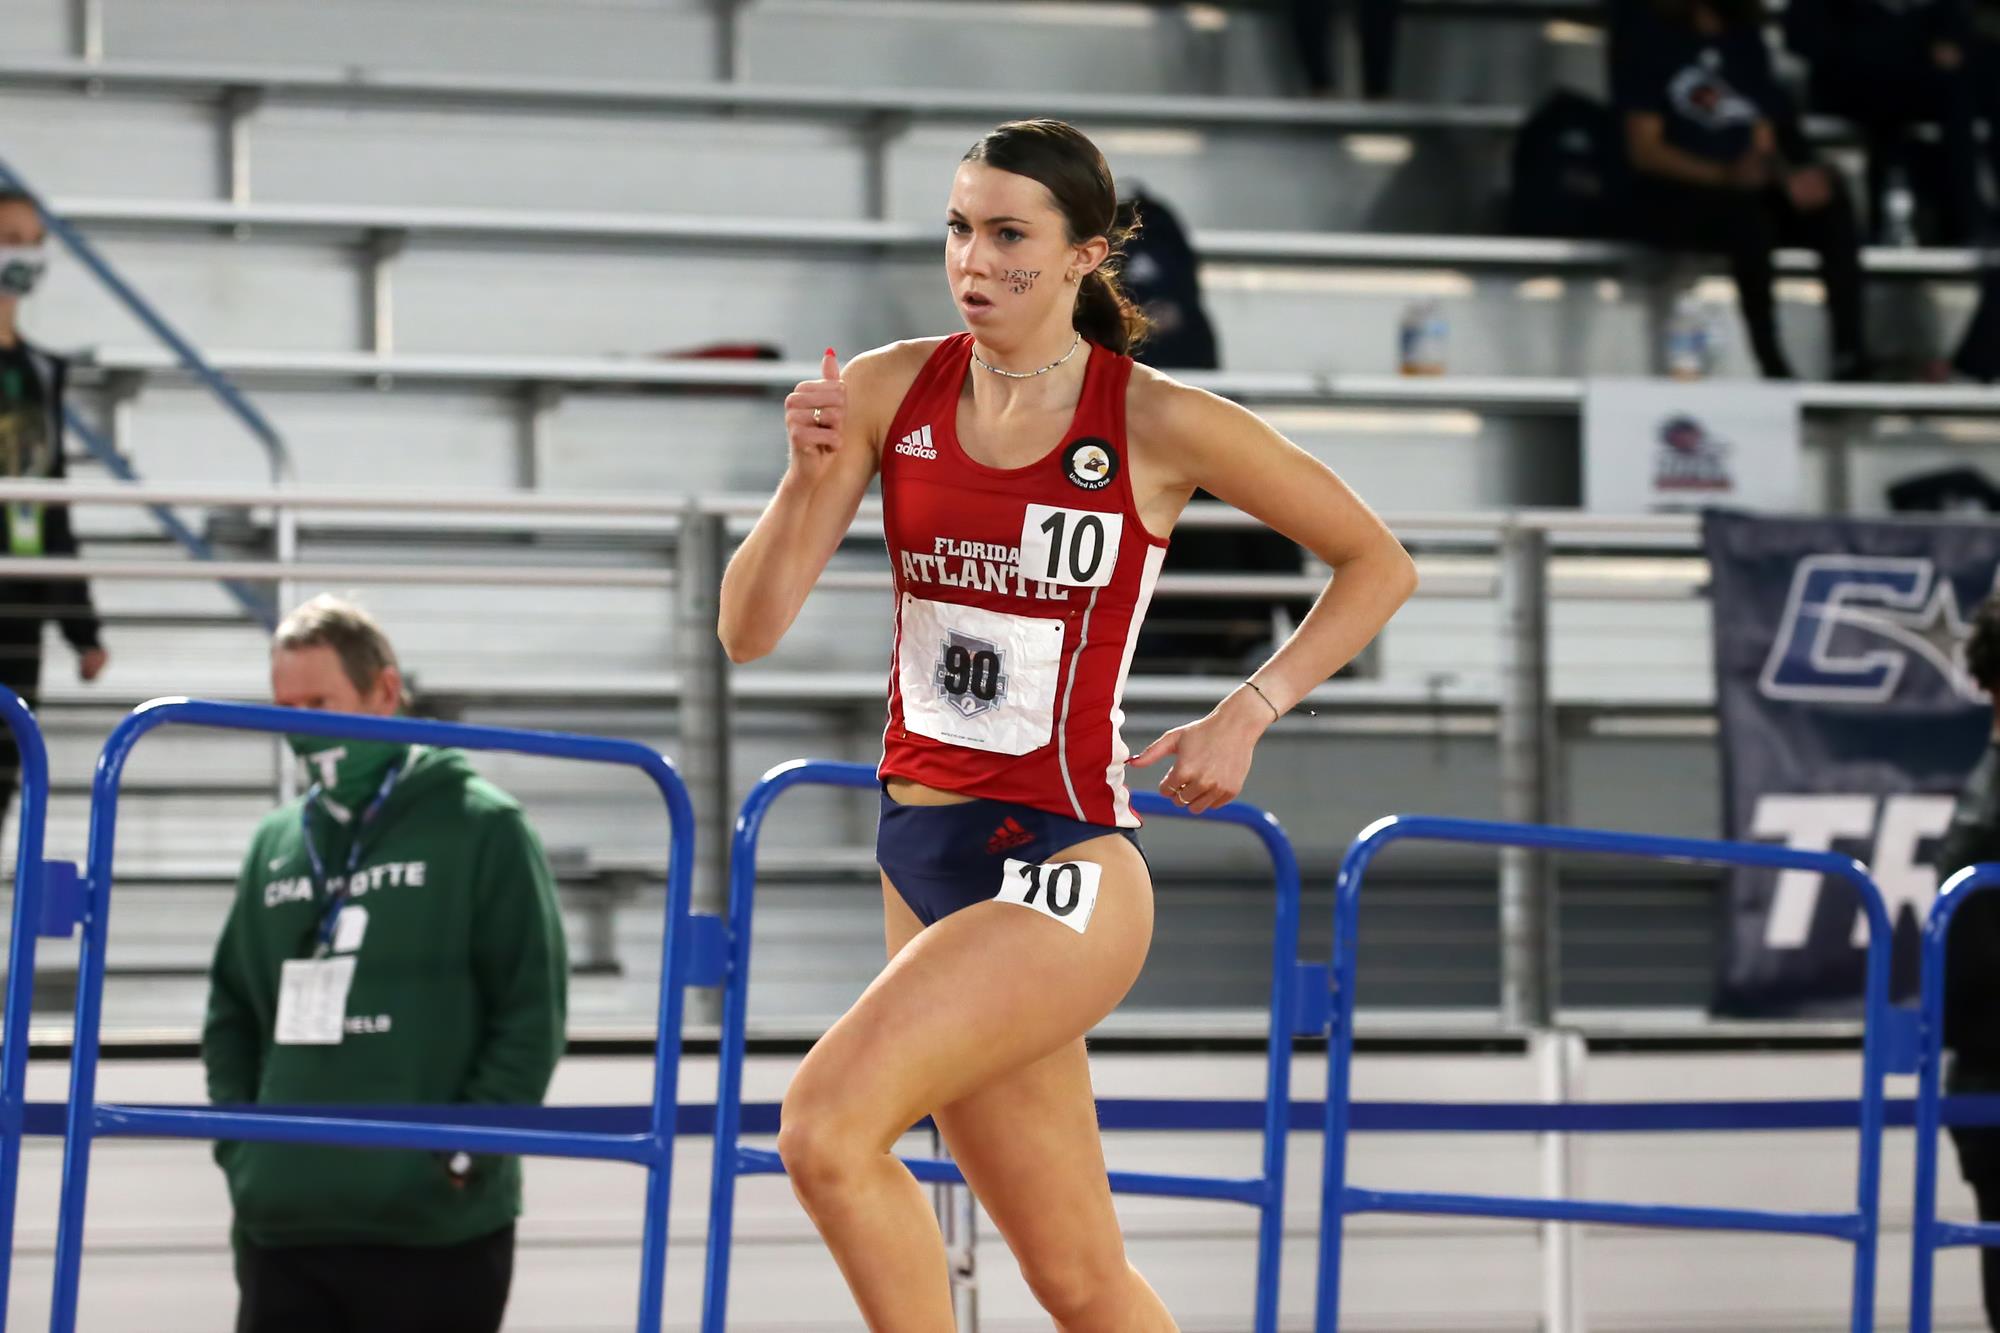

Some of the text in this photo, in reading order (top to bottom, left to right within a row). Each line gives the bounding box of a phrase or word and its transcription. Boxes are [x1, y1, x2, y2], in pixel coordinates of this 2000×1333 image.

[895, 442, 938, 460] adidas
[1069, 472, 1088, 488] United
[1097, 477, 1111, 488] One
[934, 537, 1020, 564] FLORIDA
[1040, 511, 1105, 583] 10
[944, 645, 1000, 701] 90
[1018, 862, 1082, 917] 10
